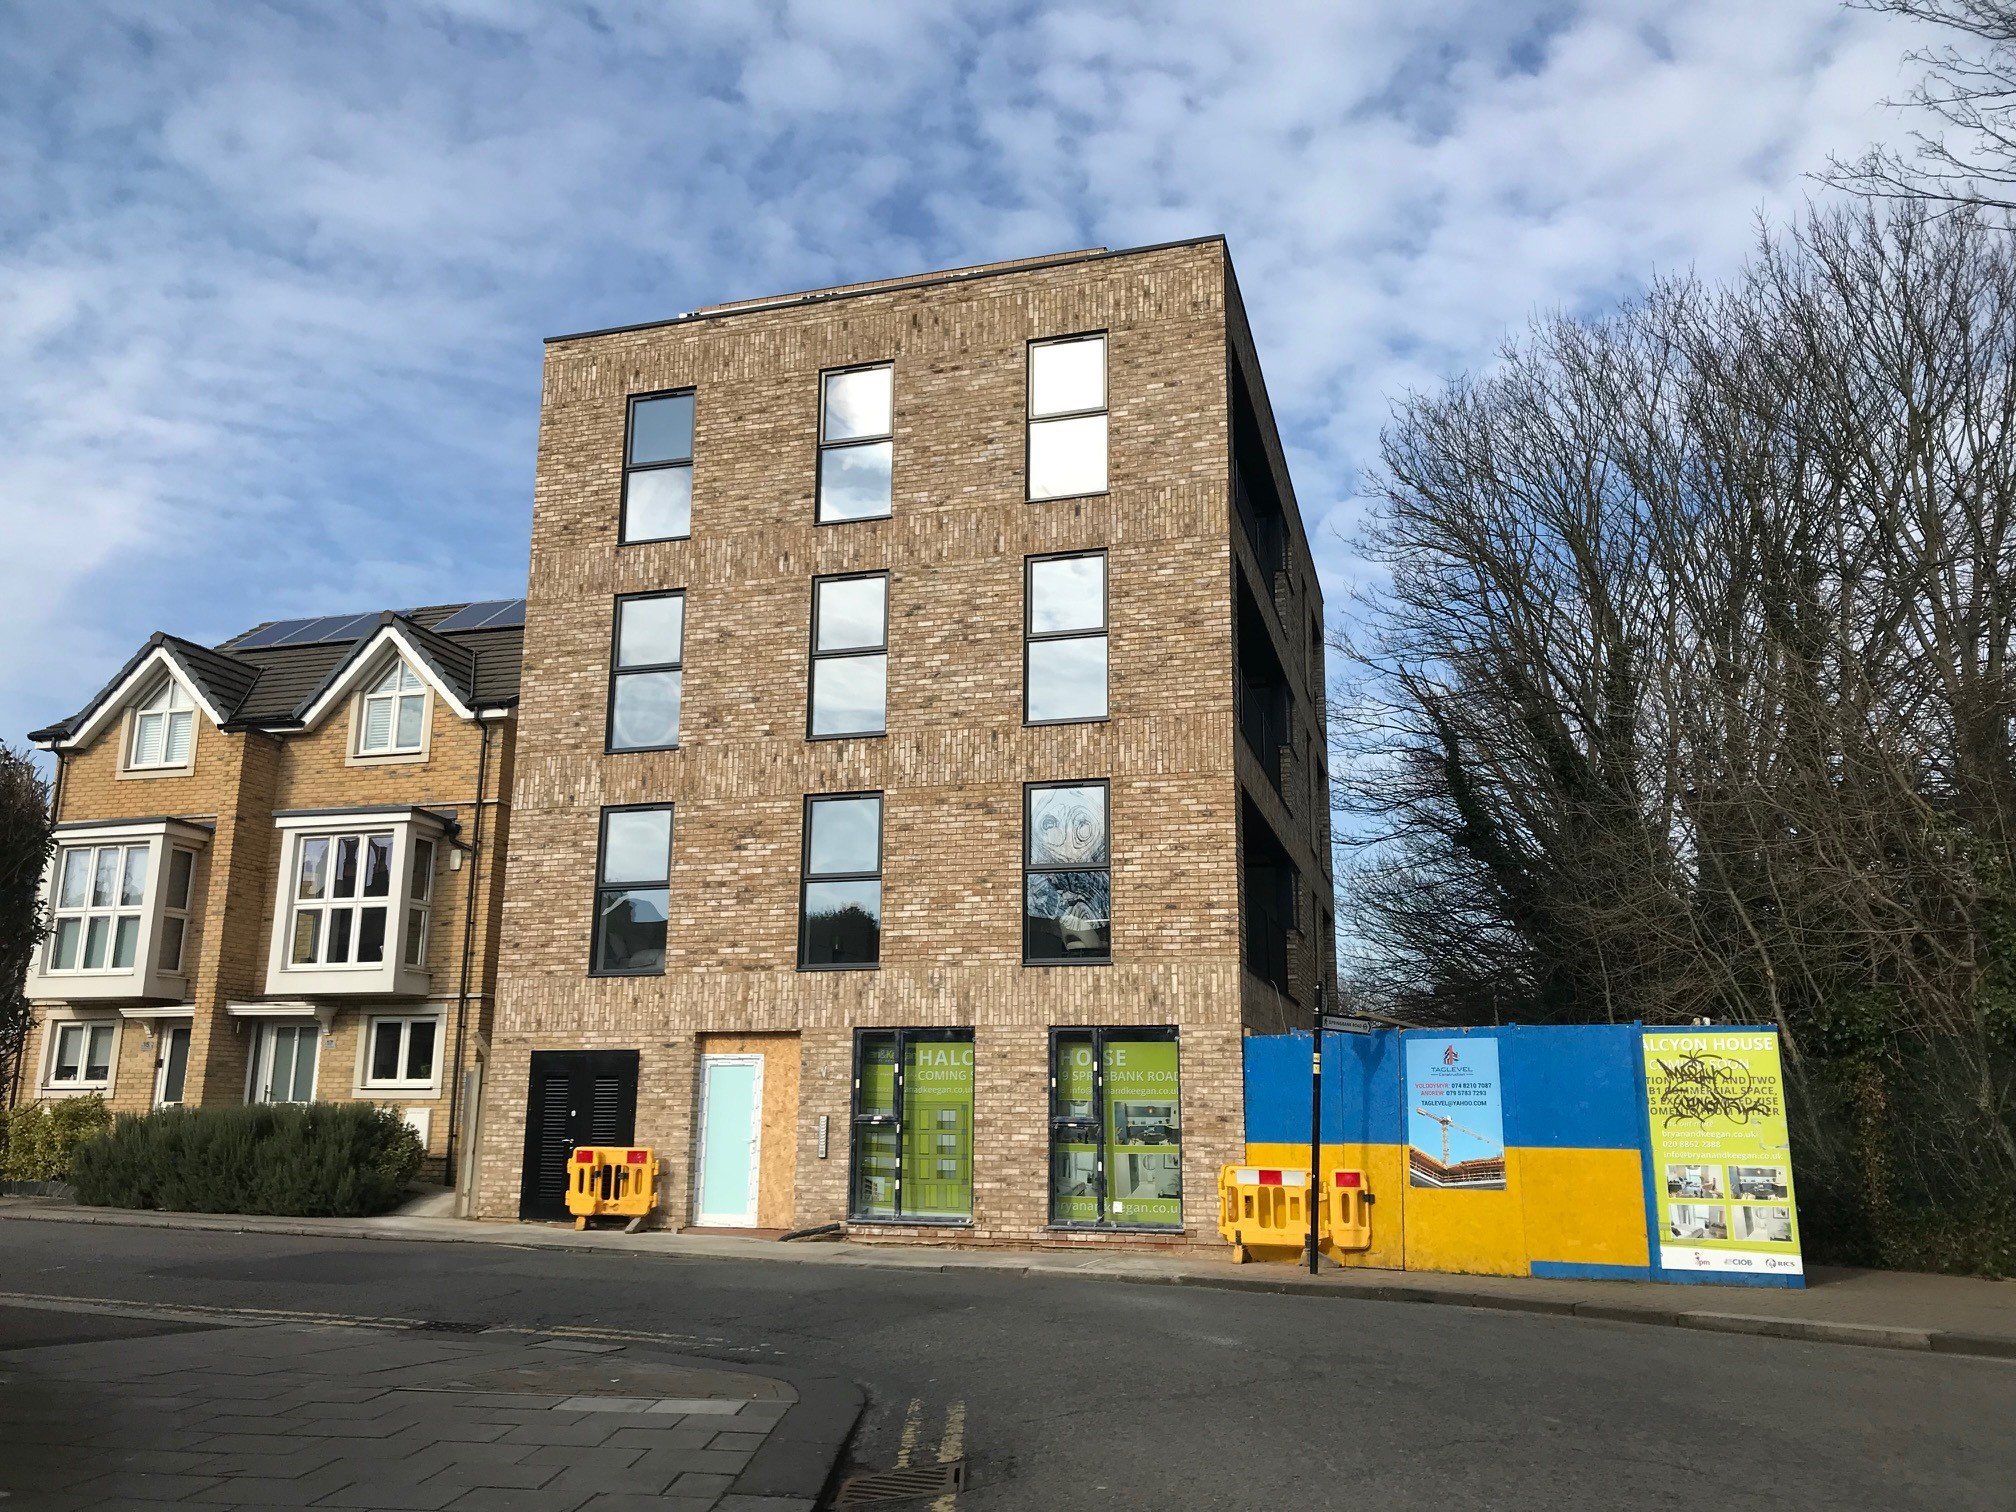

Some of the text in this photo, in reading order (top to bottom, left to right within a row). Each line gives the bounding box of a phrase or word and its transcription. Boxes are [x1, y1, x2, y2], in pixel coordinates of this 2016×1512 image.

[1713, 1037, 1774, 1051] HOUSE
[1060, 1049, 1127, 1067] HOSE
[1709, 1058, 1750, 1070] SOON
[918, 1070, 967, 1081] COMING
[1072, 1070, 1144, 1082] SPRGBANK
[1722, 1076, 1746, 1085] AND
[1750, 1076, 1777, 1085] TWO
[1649, 1086, 1661, 1095] B1
[1740, 1086, 1778, 1097] SPACE,
[1662, 1130, 1757, 1139] bryanandkeegan.co.uk
[1662, 1140, 1678, 1148] 020
[1663, 1151, 1784, 1161] info@bryanandkeegan.co.uk
[1732, 1258, 1753, 1267] CIOB
